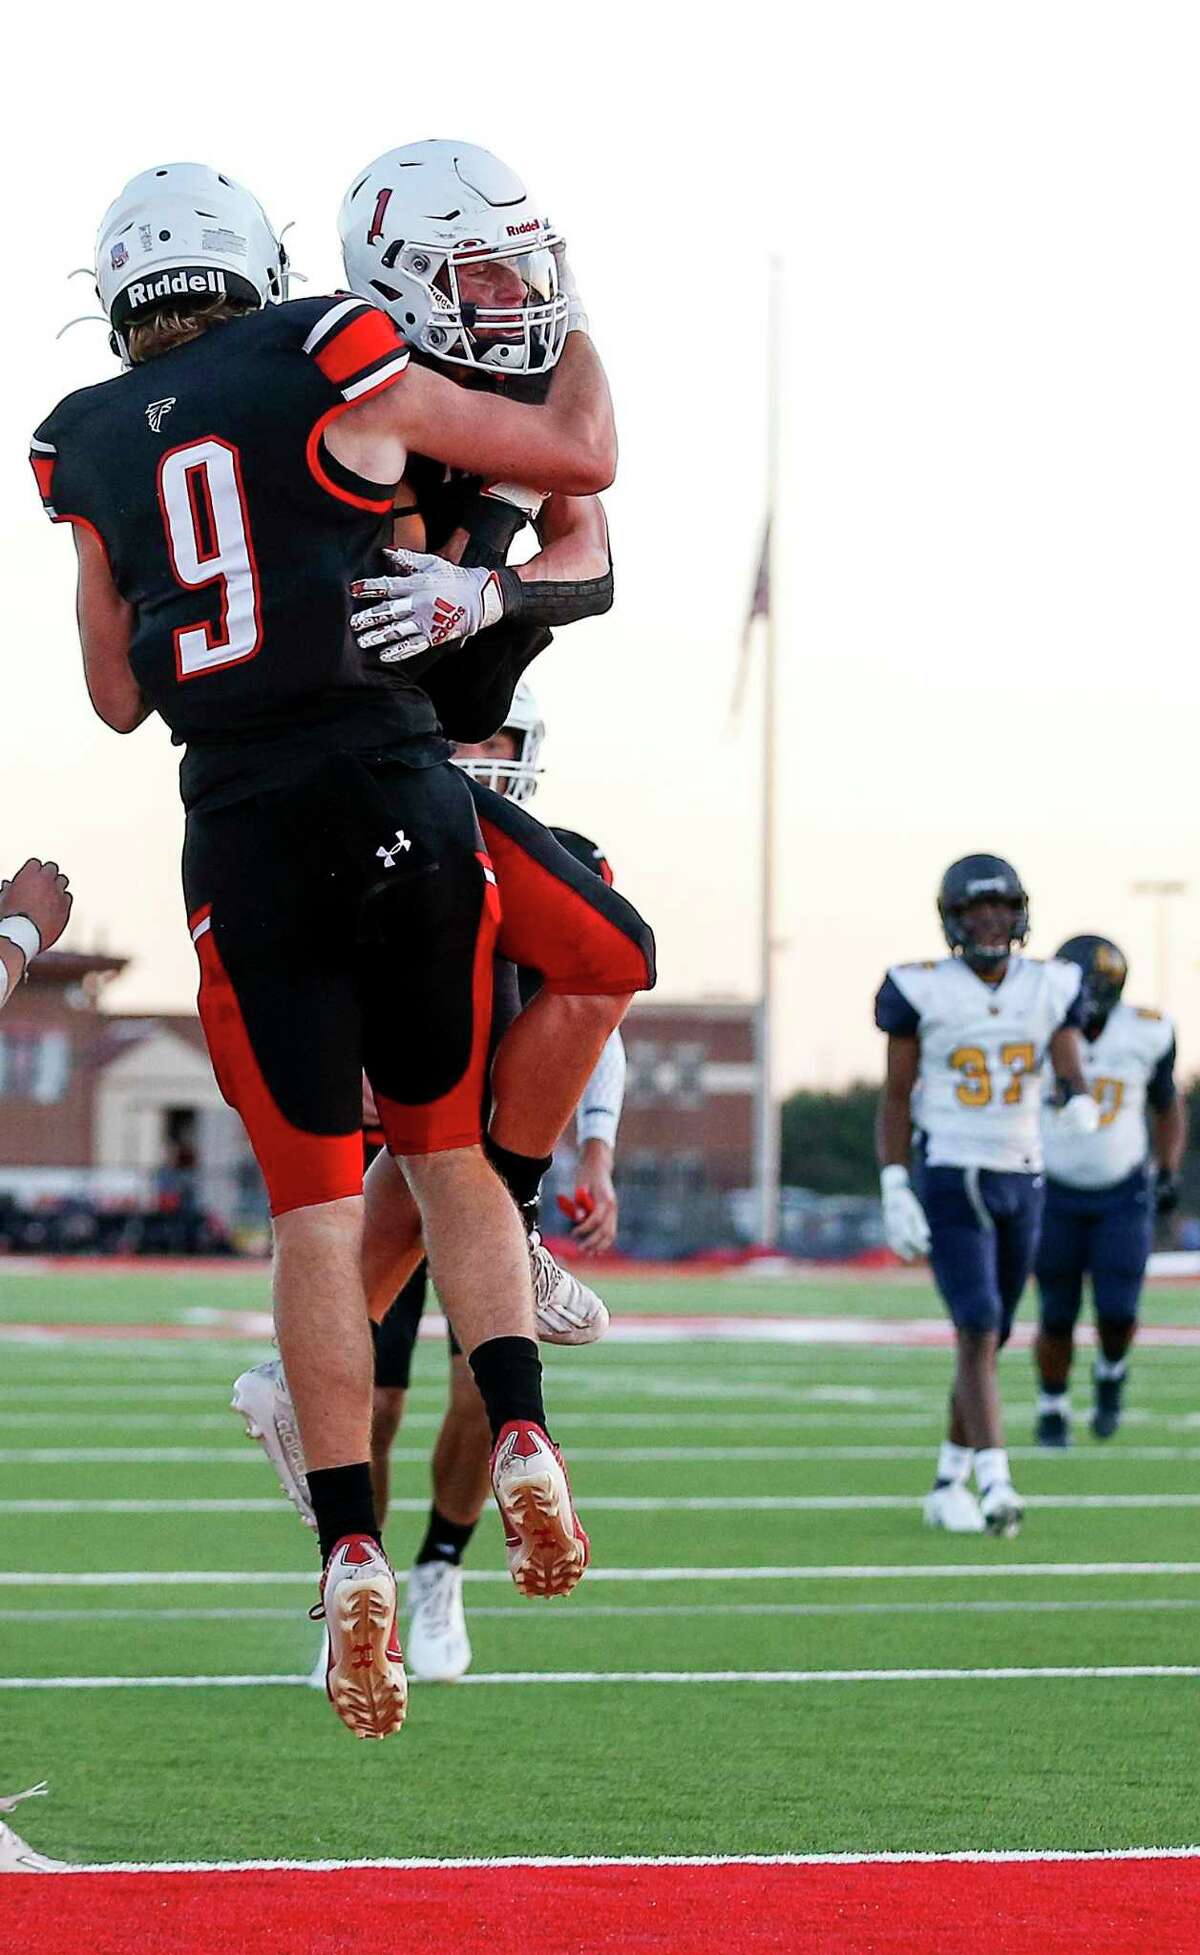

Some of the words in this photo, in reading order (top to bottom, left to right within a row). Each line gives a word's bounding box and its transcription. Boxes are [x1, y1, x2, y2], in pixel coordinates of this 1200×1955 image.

[367, 187, 393, 246] 1
[126, 271, 226, 309] Riddell
[155, 433, 264, 682] 9
[431, 605, 466, 644] adidas
[950, 1042, 1036, 1107] 37
